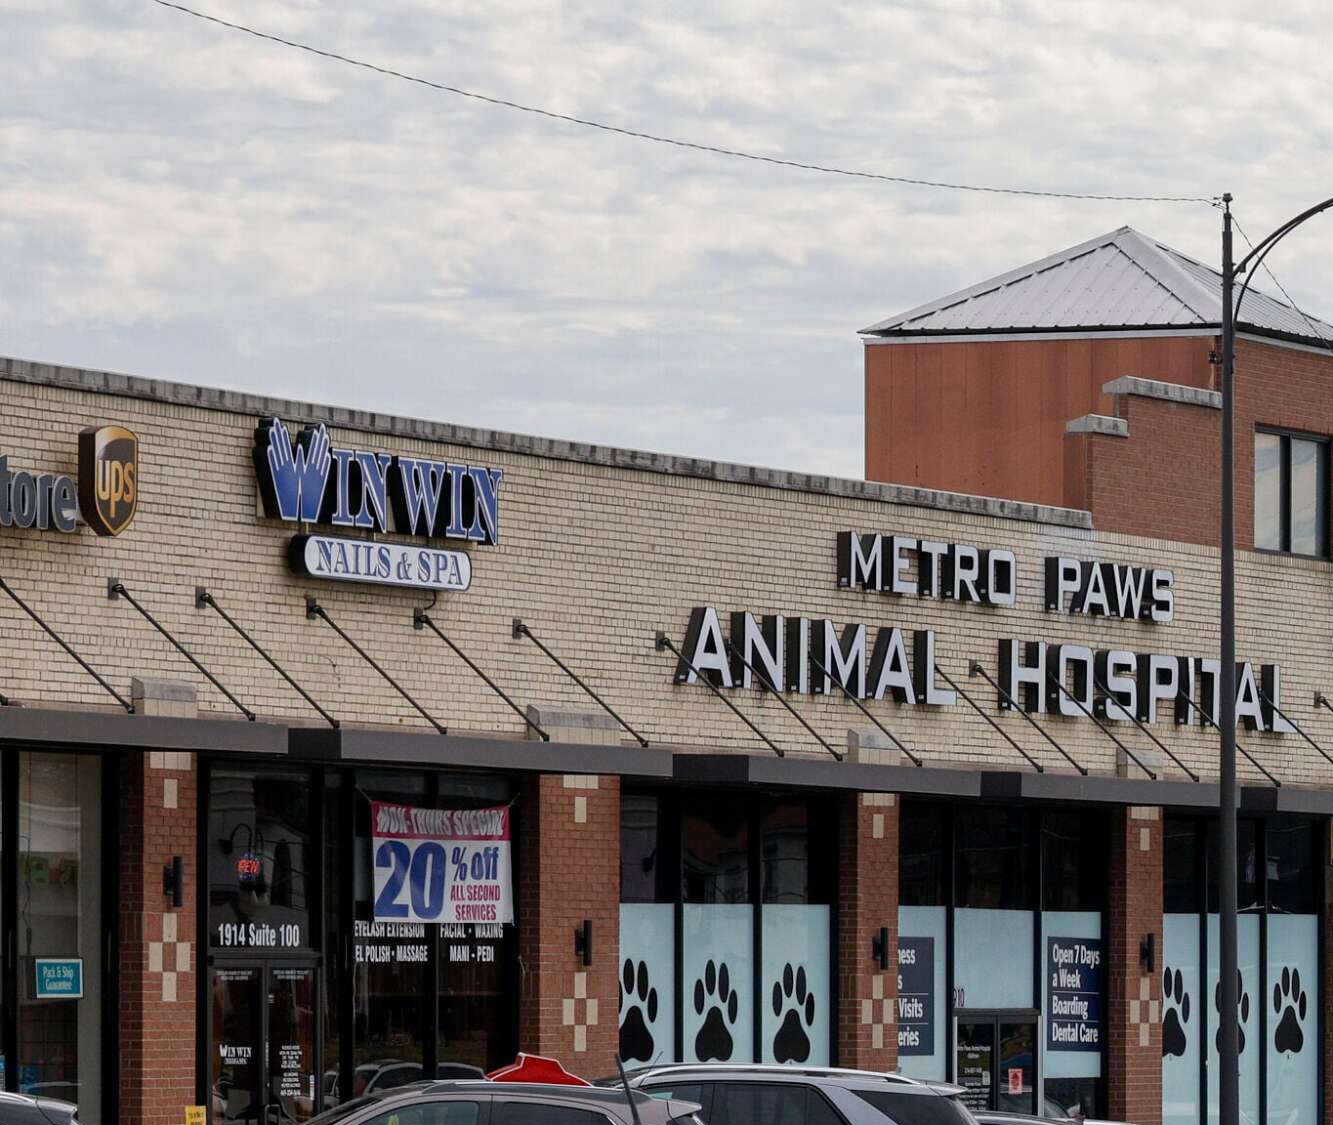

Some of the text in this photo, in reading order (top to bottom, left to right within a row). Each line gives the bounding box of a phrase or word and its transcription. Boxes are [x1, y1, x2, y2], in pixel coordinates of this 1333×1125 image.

[98, 460, 134, 518] ups
[267, 417, 503, 546] WIN WIN
[315, 540, 464, 586] NAILS & SPA
[846, 531, 1175, 623] METRO PAWS
[683, 607, 958, 706] ANIMAL
[471, 846, 499, 881] off
[450, 885, 501, 902] ALL SECOND
[455, 904, 497, 921] SERVICES
[218, 923, 300, 947] 1914 Suite 100
[354, 920, 426, 938] EYELASH EXTENSION
[440, 922, 503, 939] FACIAL WAXING
[365, 945, 391, 963] POLISH
[396, 945, 428, 963] MASSAGE
[449, 945, 495, 962] MANI PEDI
[1052, 944, 1100, 969] Open 7 Days
[1052, 970, 1081, 989] a Week
[899, 997, 923, 1018] Visits
[1052, 995, 1089, 1020] Boarding
[1052, 1023, 1098, 1043] Dental Care
